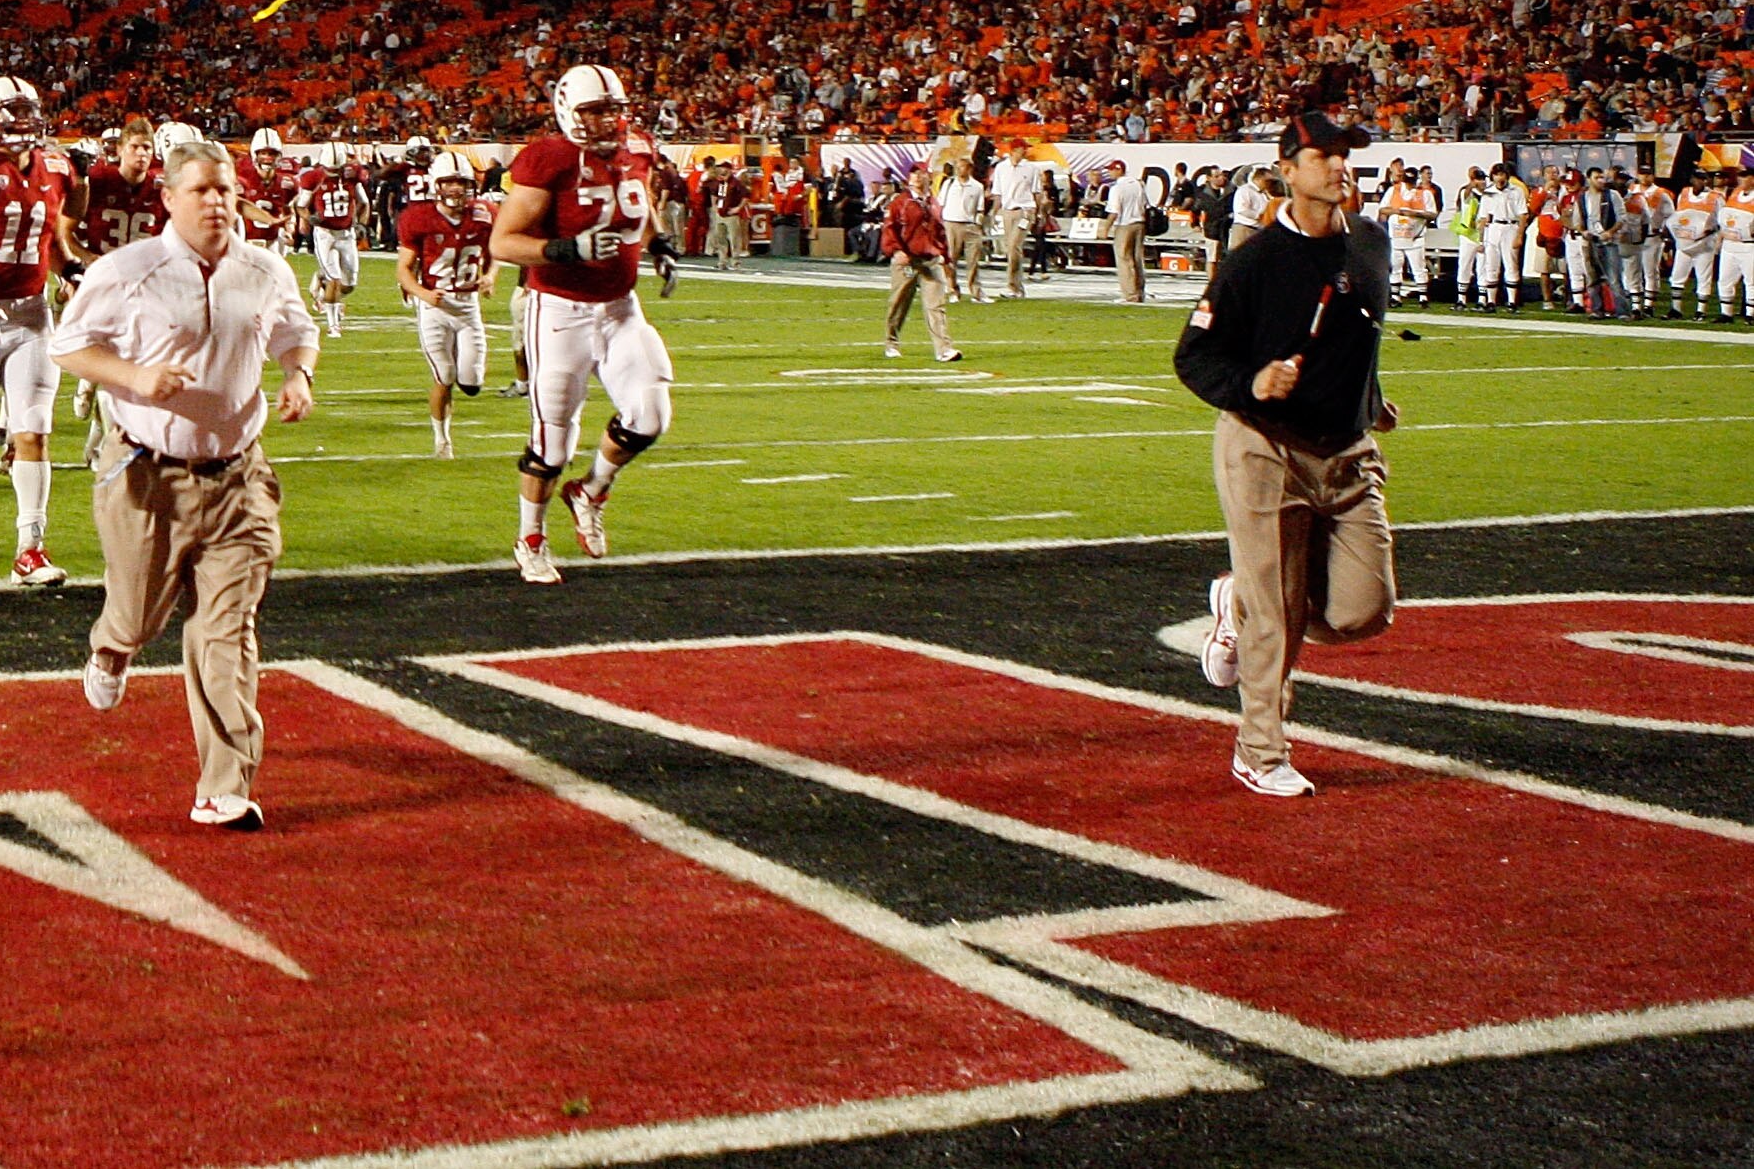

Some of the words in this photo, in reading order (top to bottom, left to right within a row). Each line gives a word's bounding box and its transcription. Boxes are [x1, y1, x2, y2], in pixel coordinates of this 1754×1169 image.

[322, 190, 350, 217] 18
[576, 179, 650, 245] 79
[99, 208, 155, 254] 36
[428, 245, 483, 291] 46
